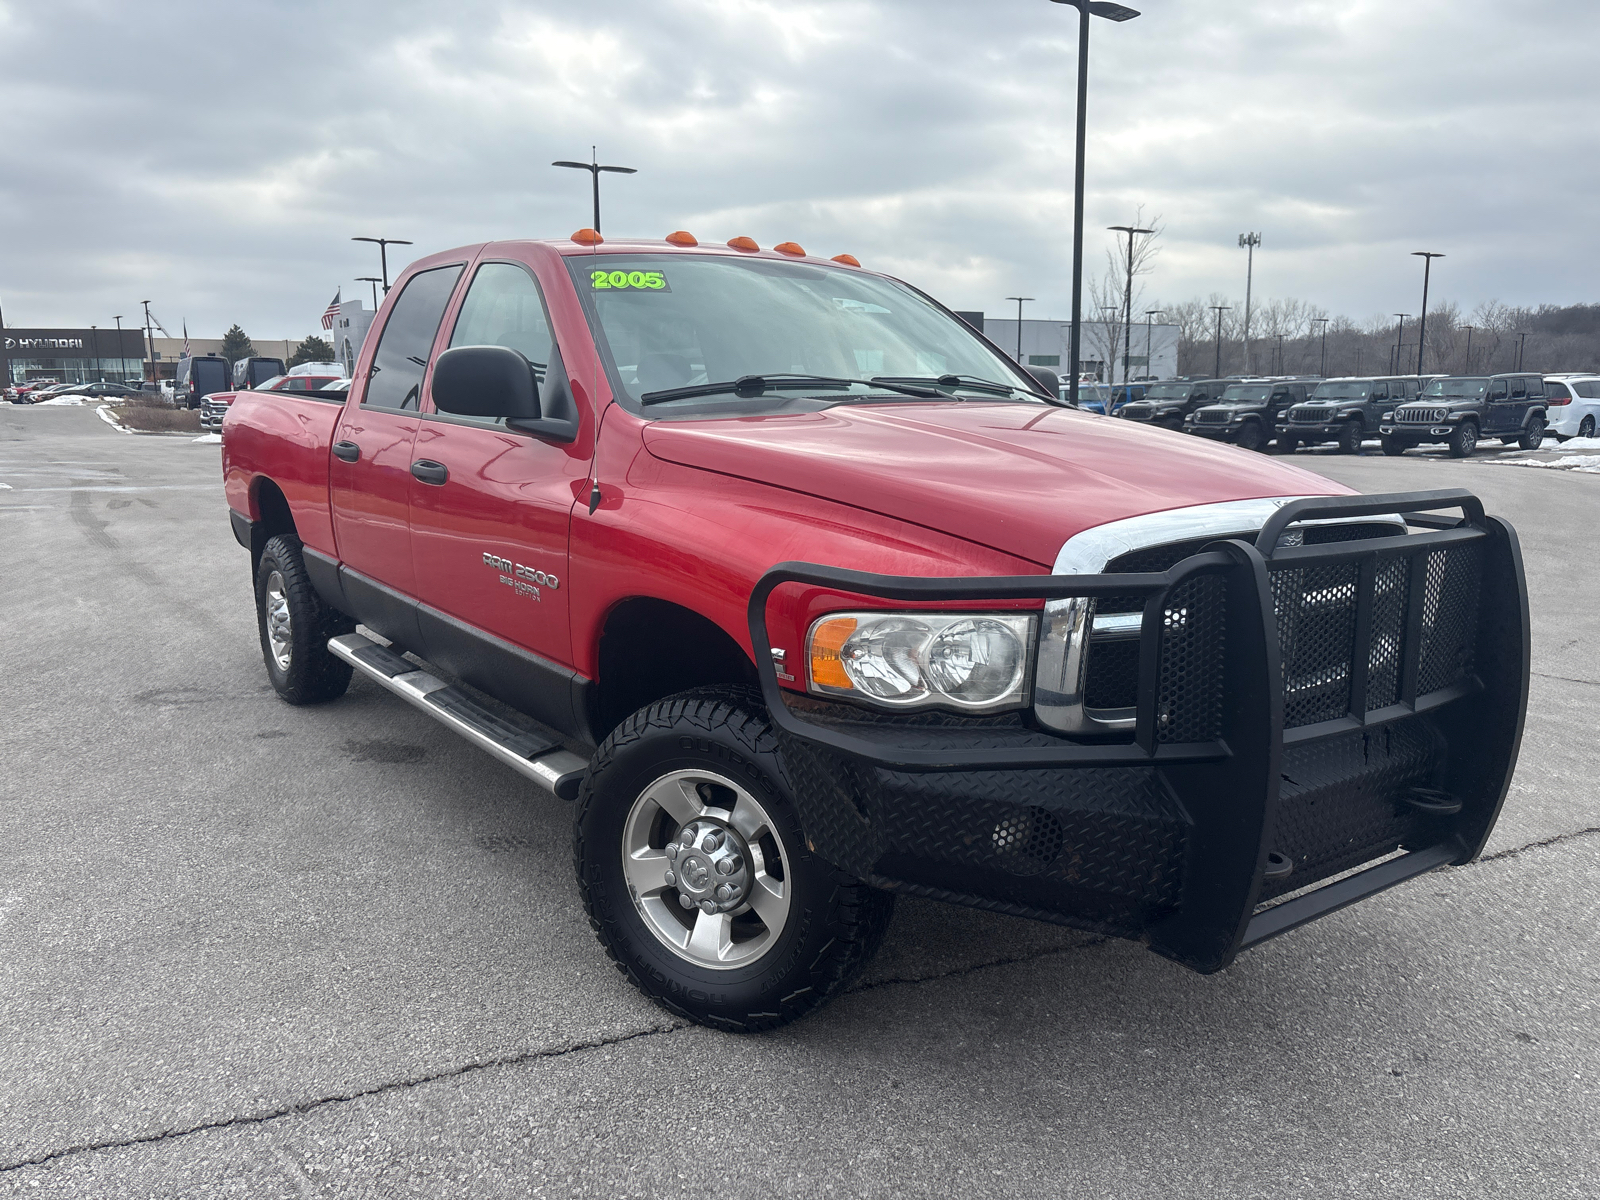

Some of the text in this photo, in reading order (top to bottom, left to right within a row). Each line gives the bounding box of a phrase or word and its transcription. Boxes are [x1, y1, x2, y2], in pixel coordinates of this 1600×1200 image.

[590, 270, 666, 289] 2005
[19, 338, 83, 349] HYUNDAI
[483, 552, 559, 590] RAM 2500
[499, 574, 541, 597] BIG HORN
[515, 588, 541, 603] EDITION
[679, 735, 791, 807] OUTPOST
[588, 863, 632, 952] TYRES
